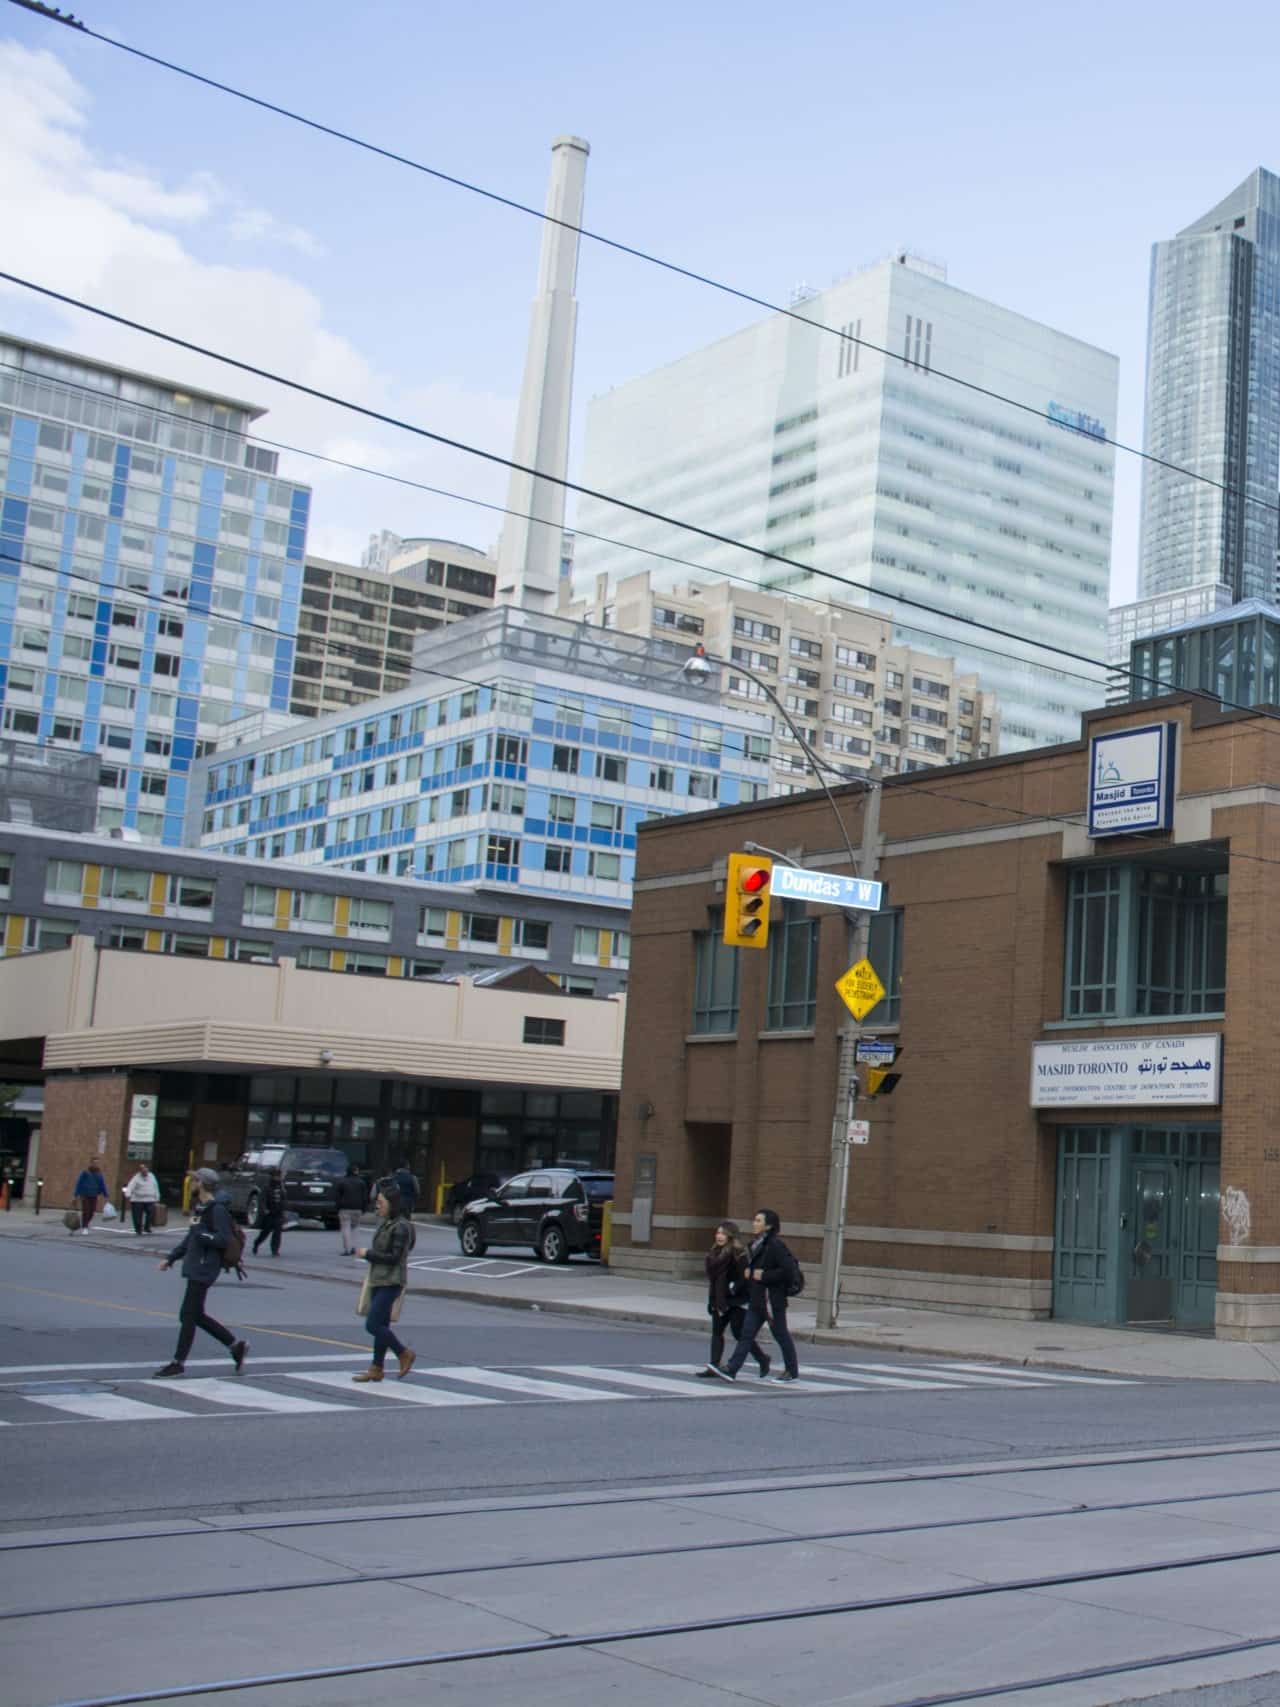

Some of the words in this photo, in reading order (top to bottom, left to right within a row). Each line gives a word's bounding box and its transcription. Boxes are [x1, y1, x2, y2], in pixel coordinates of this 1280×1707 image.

[1096, 788, 1126, 801] Masjid
[782, 871, 840, 897] Dundas
[859, 883, 872, 901] W
[1155, 1040, 1185, 1048] CANADA
[1037, 1062, 1075, 1076] MASJID
[1077, 1061, 1129, 1075] TORONTO
[1137, 1056, 1168, 1076] تورنتو
[1170, 1058, 1212, 1075] مسجد
